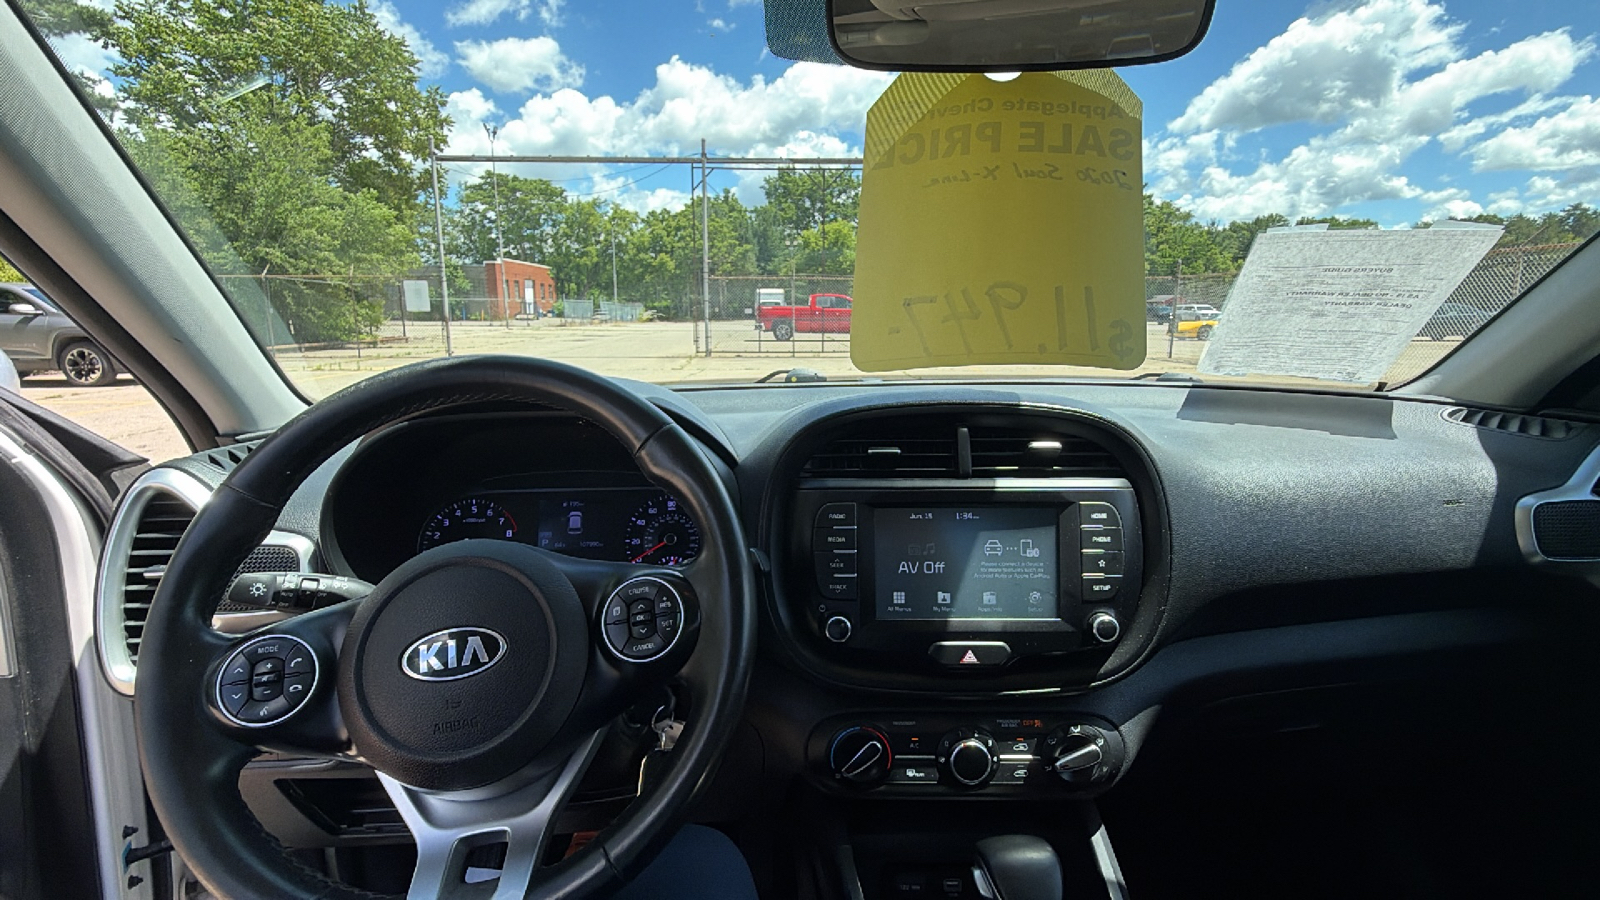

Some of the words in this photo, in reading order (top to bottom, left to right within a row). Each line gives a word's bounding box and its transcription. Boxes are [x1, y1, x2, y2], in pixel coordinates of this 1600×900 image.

[898, 561, 919, 574] AV
[923, 561, 946, 574] Off
[629, 586, 649, 595] CRUISE
[258, 645, 279, 654] MODE
[633, 643, 656, 651] CANCEL
[418, 636, 489, 673] KIA
